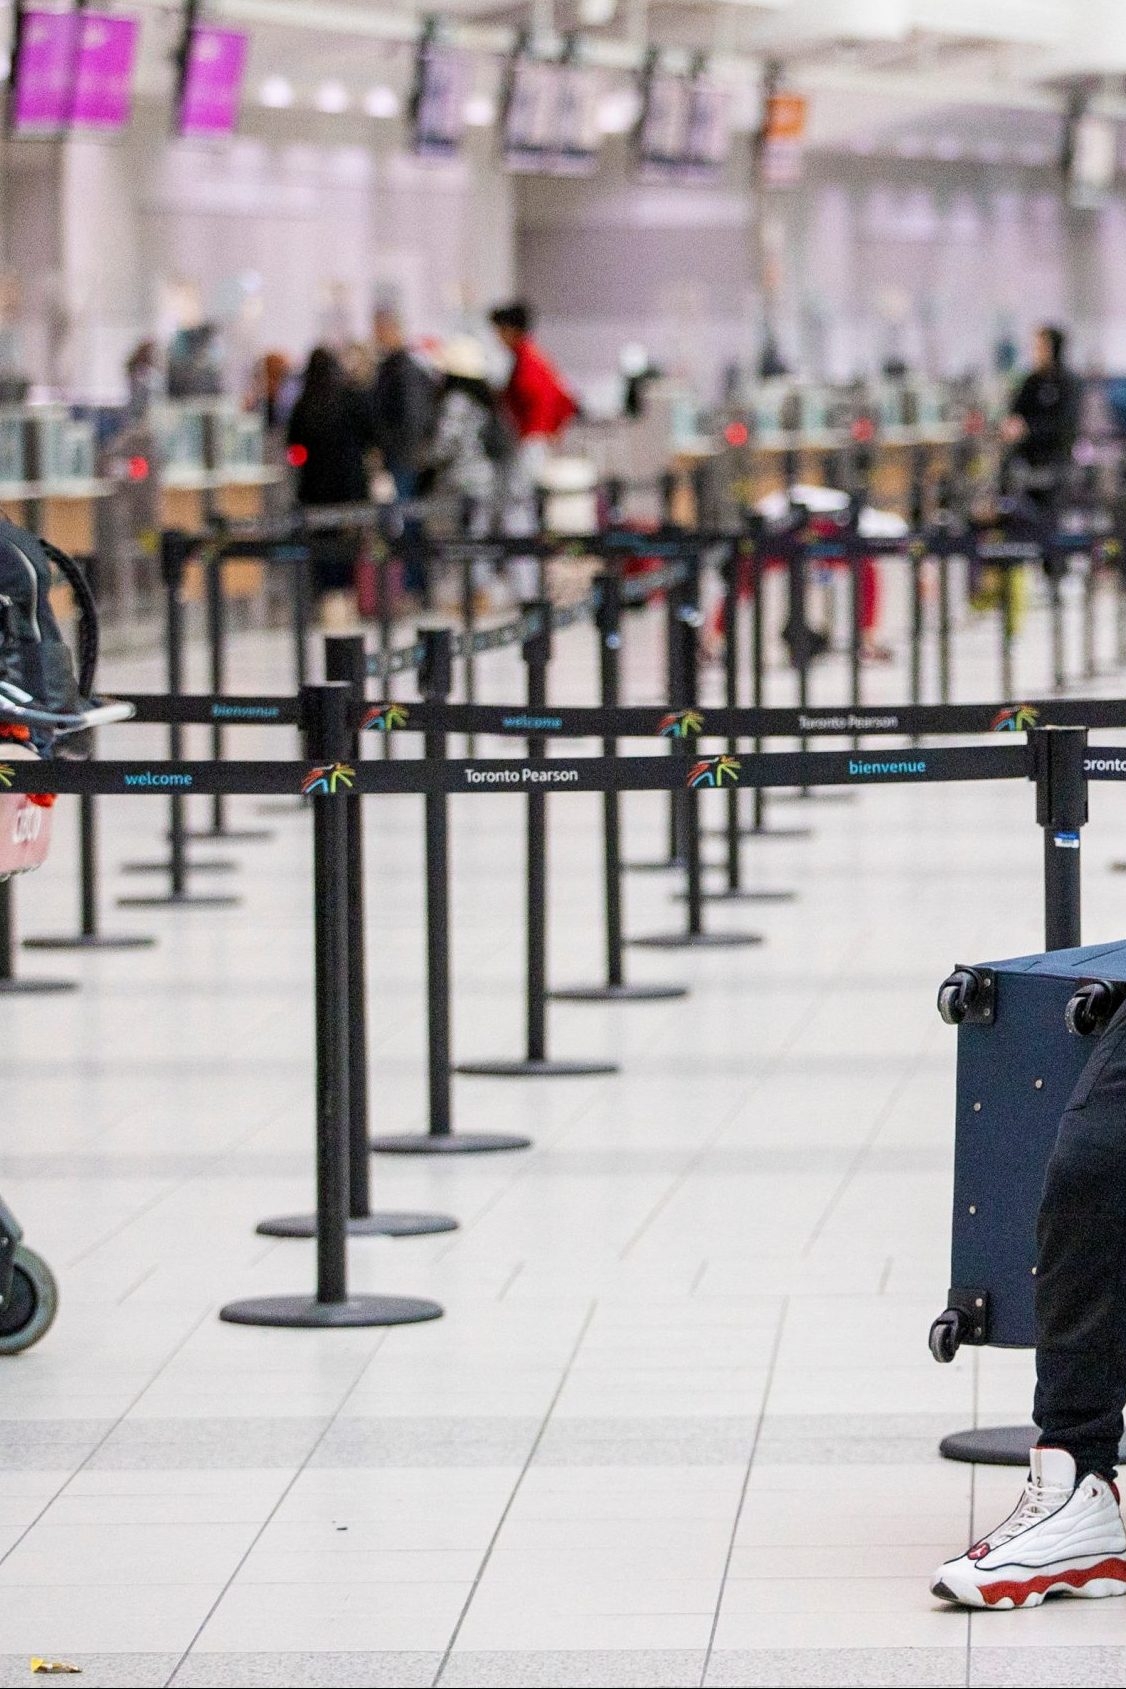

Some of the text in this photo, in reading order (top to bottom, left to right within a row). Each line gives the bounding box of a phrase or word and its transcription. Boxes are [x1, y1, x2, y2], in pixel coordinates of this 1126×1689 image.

[212, 703, 280, 717] bienvenue
[503, 714, 563, 729] welcome
[799, 713, 899, 730] Toronto Pearson
[465, 767, 579, 783] Toronto Pearson
[848, 760, 927, 775] bienvenue
[125, 771, 193, 786] welcome
